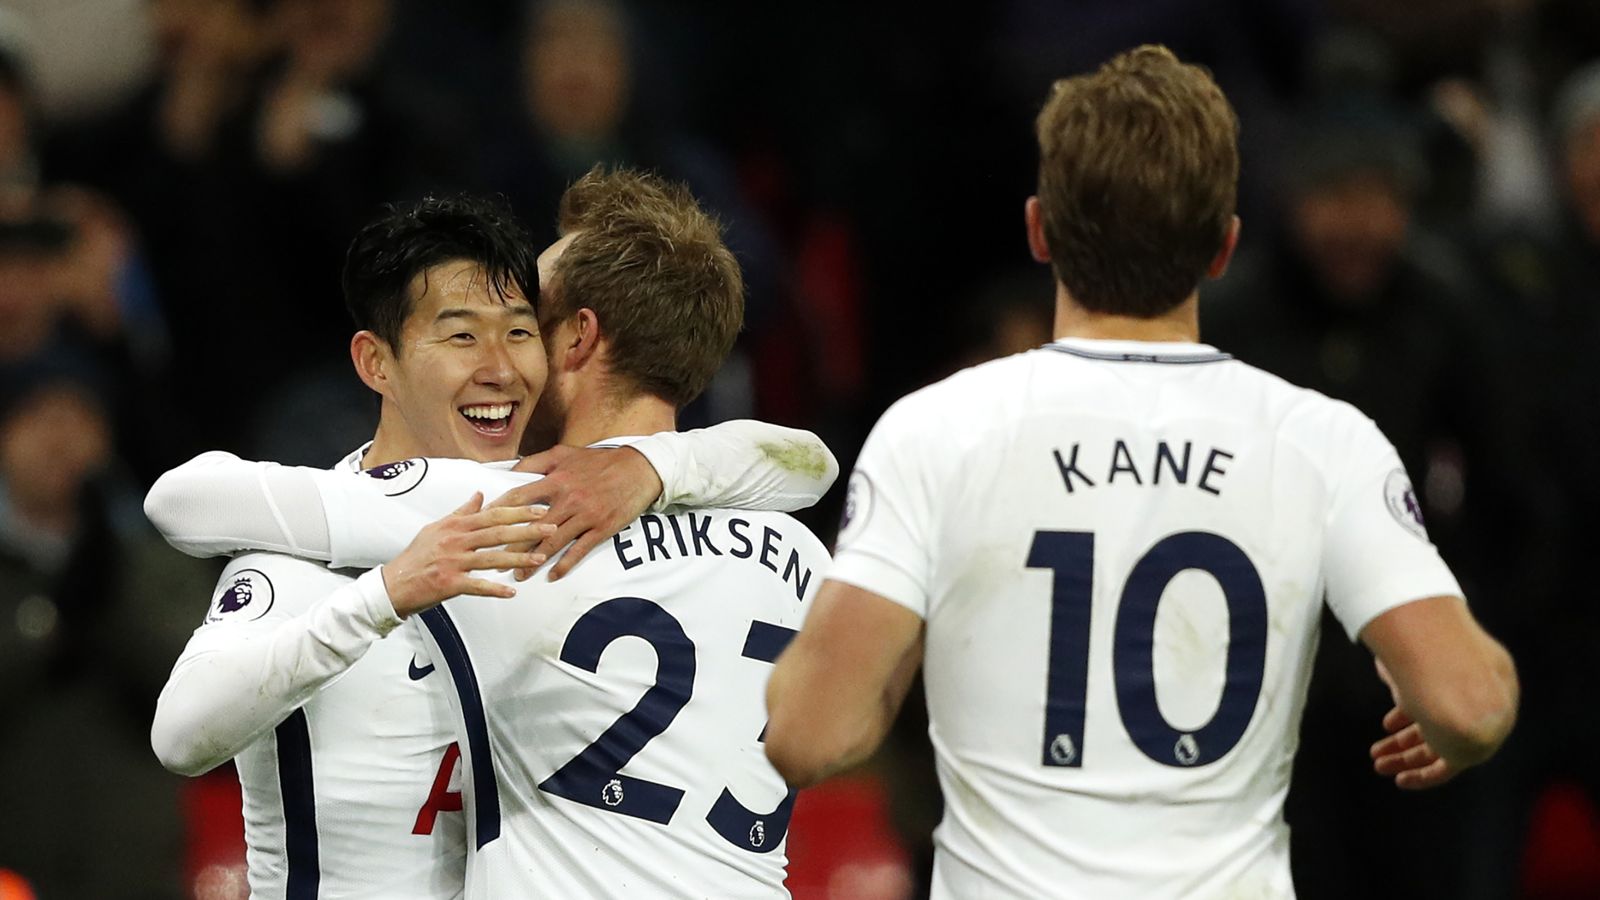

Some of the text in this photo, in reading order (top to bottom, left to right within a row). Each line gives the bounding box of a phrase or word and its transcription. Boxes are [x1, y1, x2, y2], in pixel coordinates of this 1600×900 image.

[1053, 440, 1235, 495] KANE
[612, 513, 812, 602] ERIKSEN
[1025, 529, 1268, 768] 10
